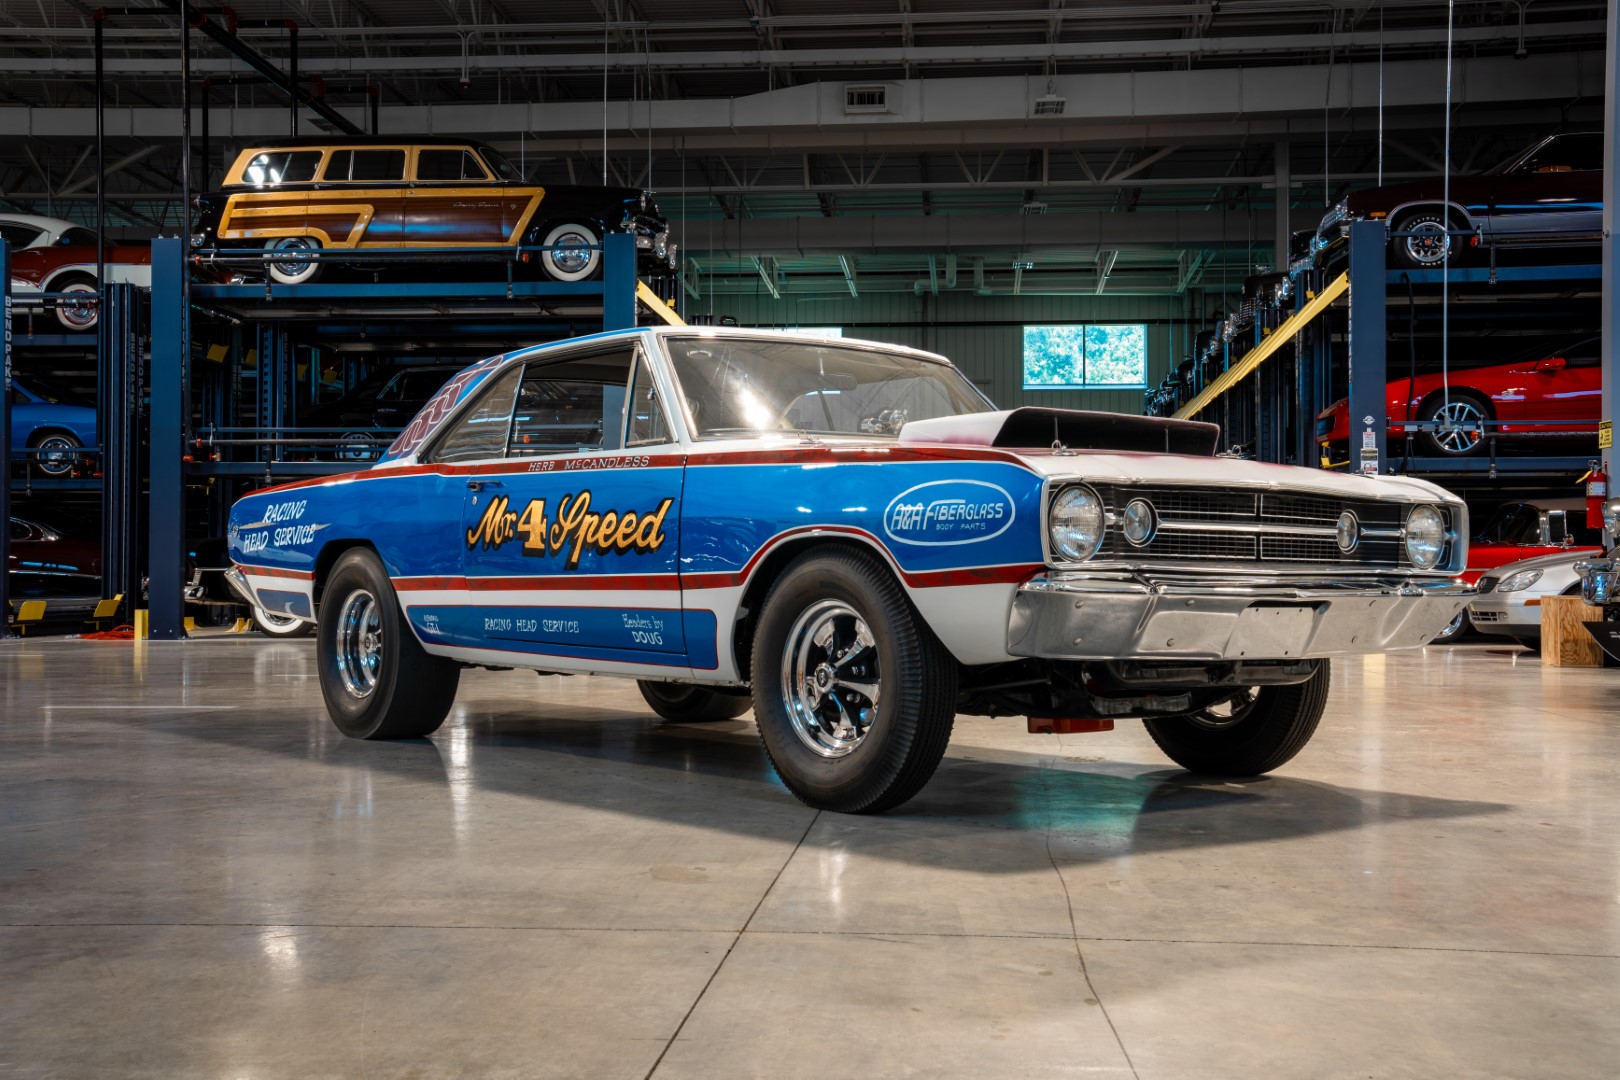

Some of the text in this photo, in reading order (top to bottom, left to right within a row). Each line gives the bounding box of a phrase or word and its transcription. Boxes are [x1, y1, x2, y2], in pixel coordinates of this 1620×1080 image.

[528, 455, 650, 472] HERB McCANDLESS
[262, 499, 307, 524] RACING
[890, 499, 1004, 530] A&A FIBERGLASS
[466, 489, 675, 570] Mr. 4 Speed
[960, 522, 986, 530] PARTS
[243, 523, 316, 554] HEAD SERVICE
[484, 617, 580, 633] RACING HEAD SERVICE
[651, 615, 664, 632] by
[632, 630, 663, 645] DOUG
